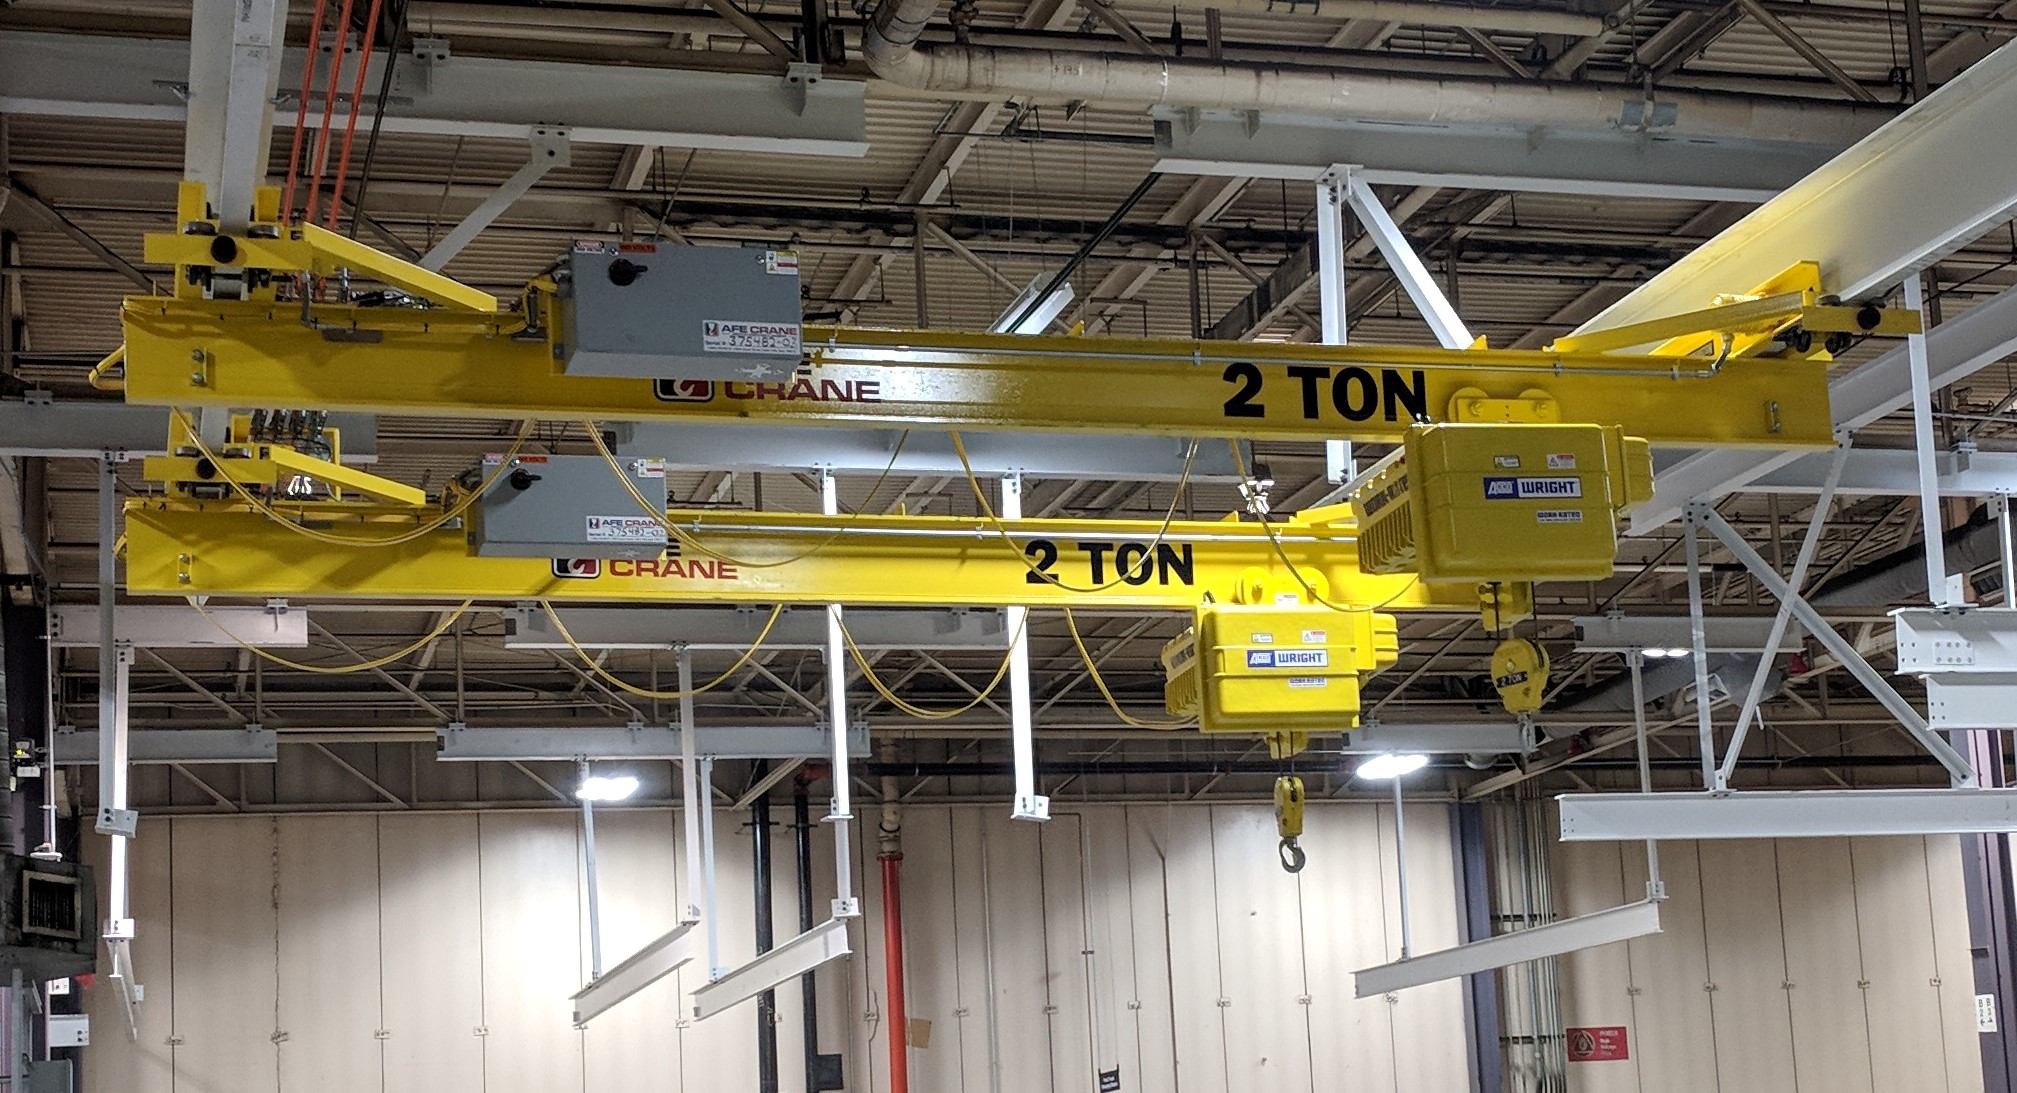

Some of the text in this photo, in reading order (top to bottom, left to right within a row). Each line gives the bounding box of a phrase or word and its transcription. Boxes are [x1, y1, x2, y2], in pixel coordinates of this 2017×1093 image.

[721, 325, 798, 335] AFE CRANE
[724, 378, 882, 403] CRANE
[1222, 362, 1428, 422] 2 TON
[1521, 481, 1576, 494] WRIGHT
[609, 558, 738, 580] CRANE
[1025, 539, 1194, 585] 2 TON
[1277, 652, 1324, 663] WRIGHT
